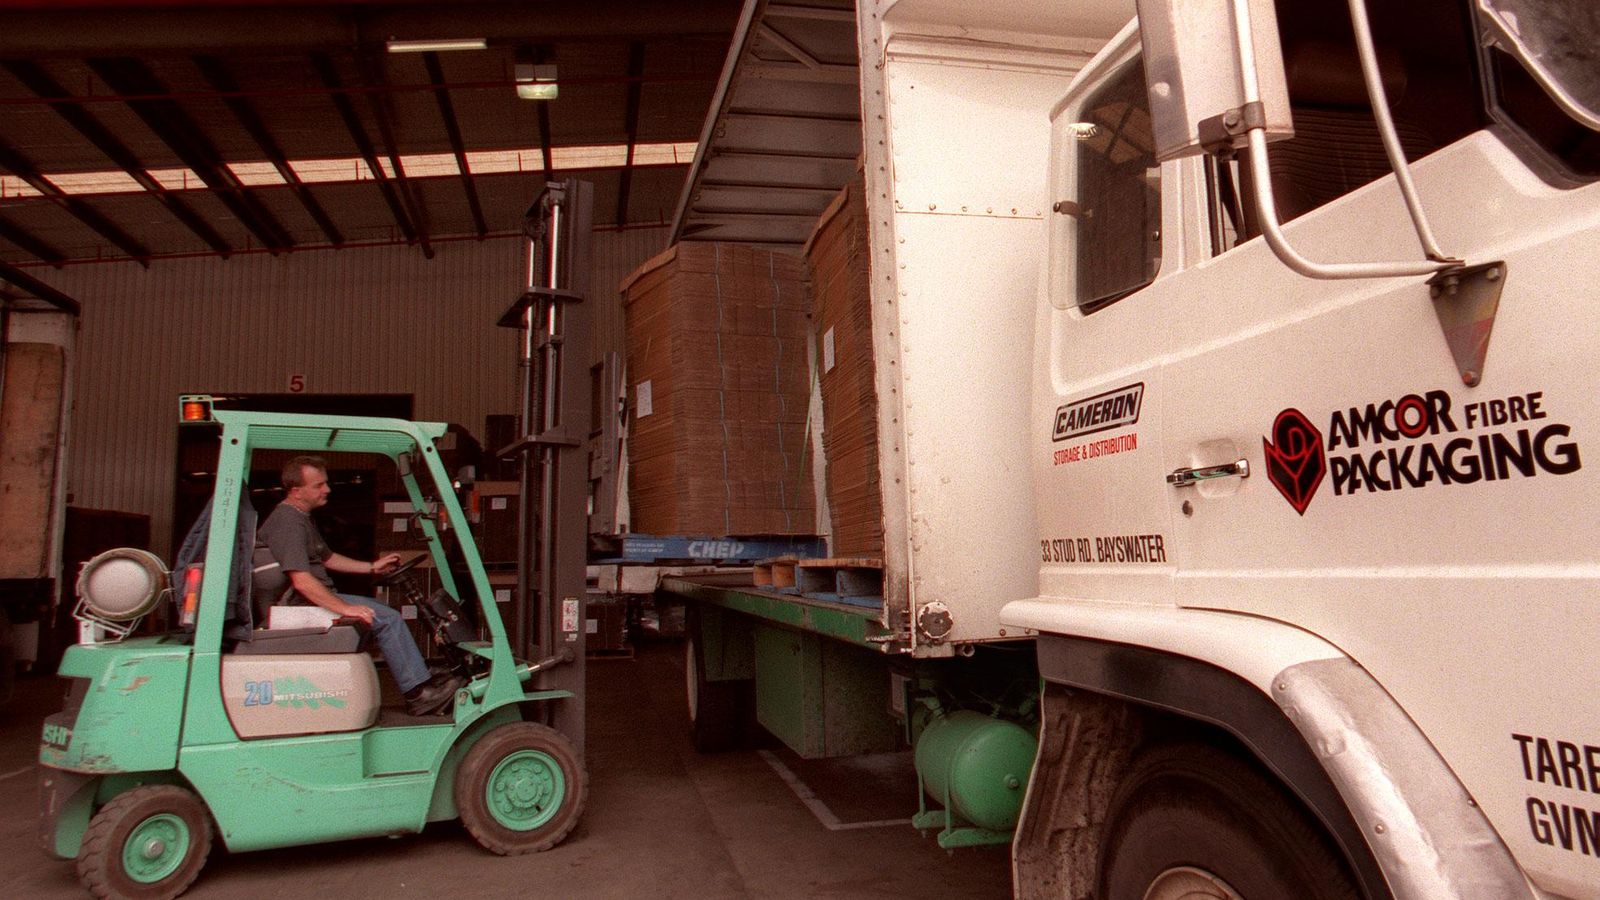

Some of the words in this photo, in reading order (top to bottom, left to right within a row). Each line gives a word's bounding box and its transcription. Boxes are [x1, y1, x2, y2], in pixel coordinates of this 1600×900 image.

[290, 375, 304, 393] 5
[1055, 391, 1138, 434] CAMERON
[1328, 389, 1458, 451] AMCOR
[1464, 391, 1547, 430] FIBRE
[1053, 446, 1081, 466] STORAGE
[1081, 444, 1088, 460] &
[1089, 433, 1138, 459] DISTRIBUTION
[1329, 423, 1582, 496] PACKAGING
[687, 540, 745, 558] CHEP
[1041, 540, 1052, 562] 33
[1053, 539, 1076, 562] STUD
[1077, 538, 1096, 562] RD.
[1096, 534, 1167, 563] BAYSWATER
[244, 680, 273, 707] 20
[273, 690, 349, 701] MITSUBISHI
[1511, 733, 1600, 795] TARE
